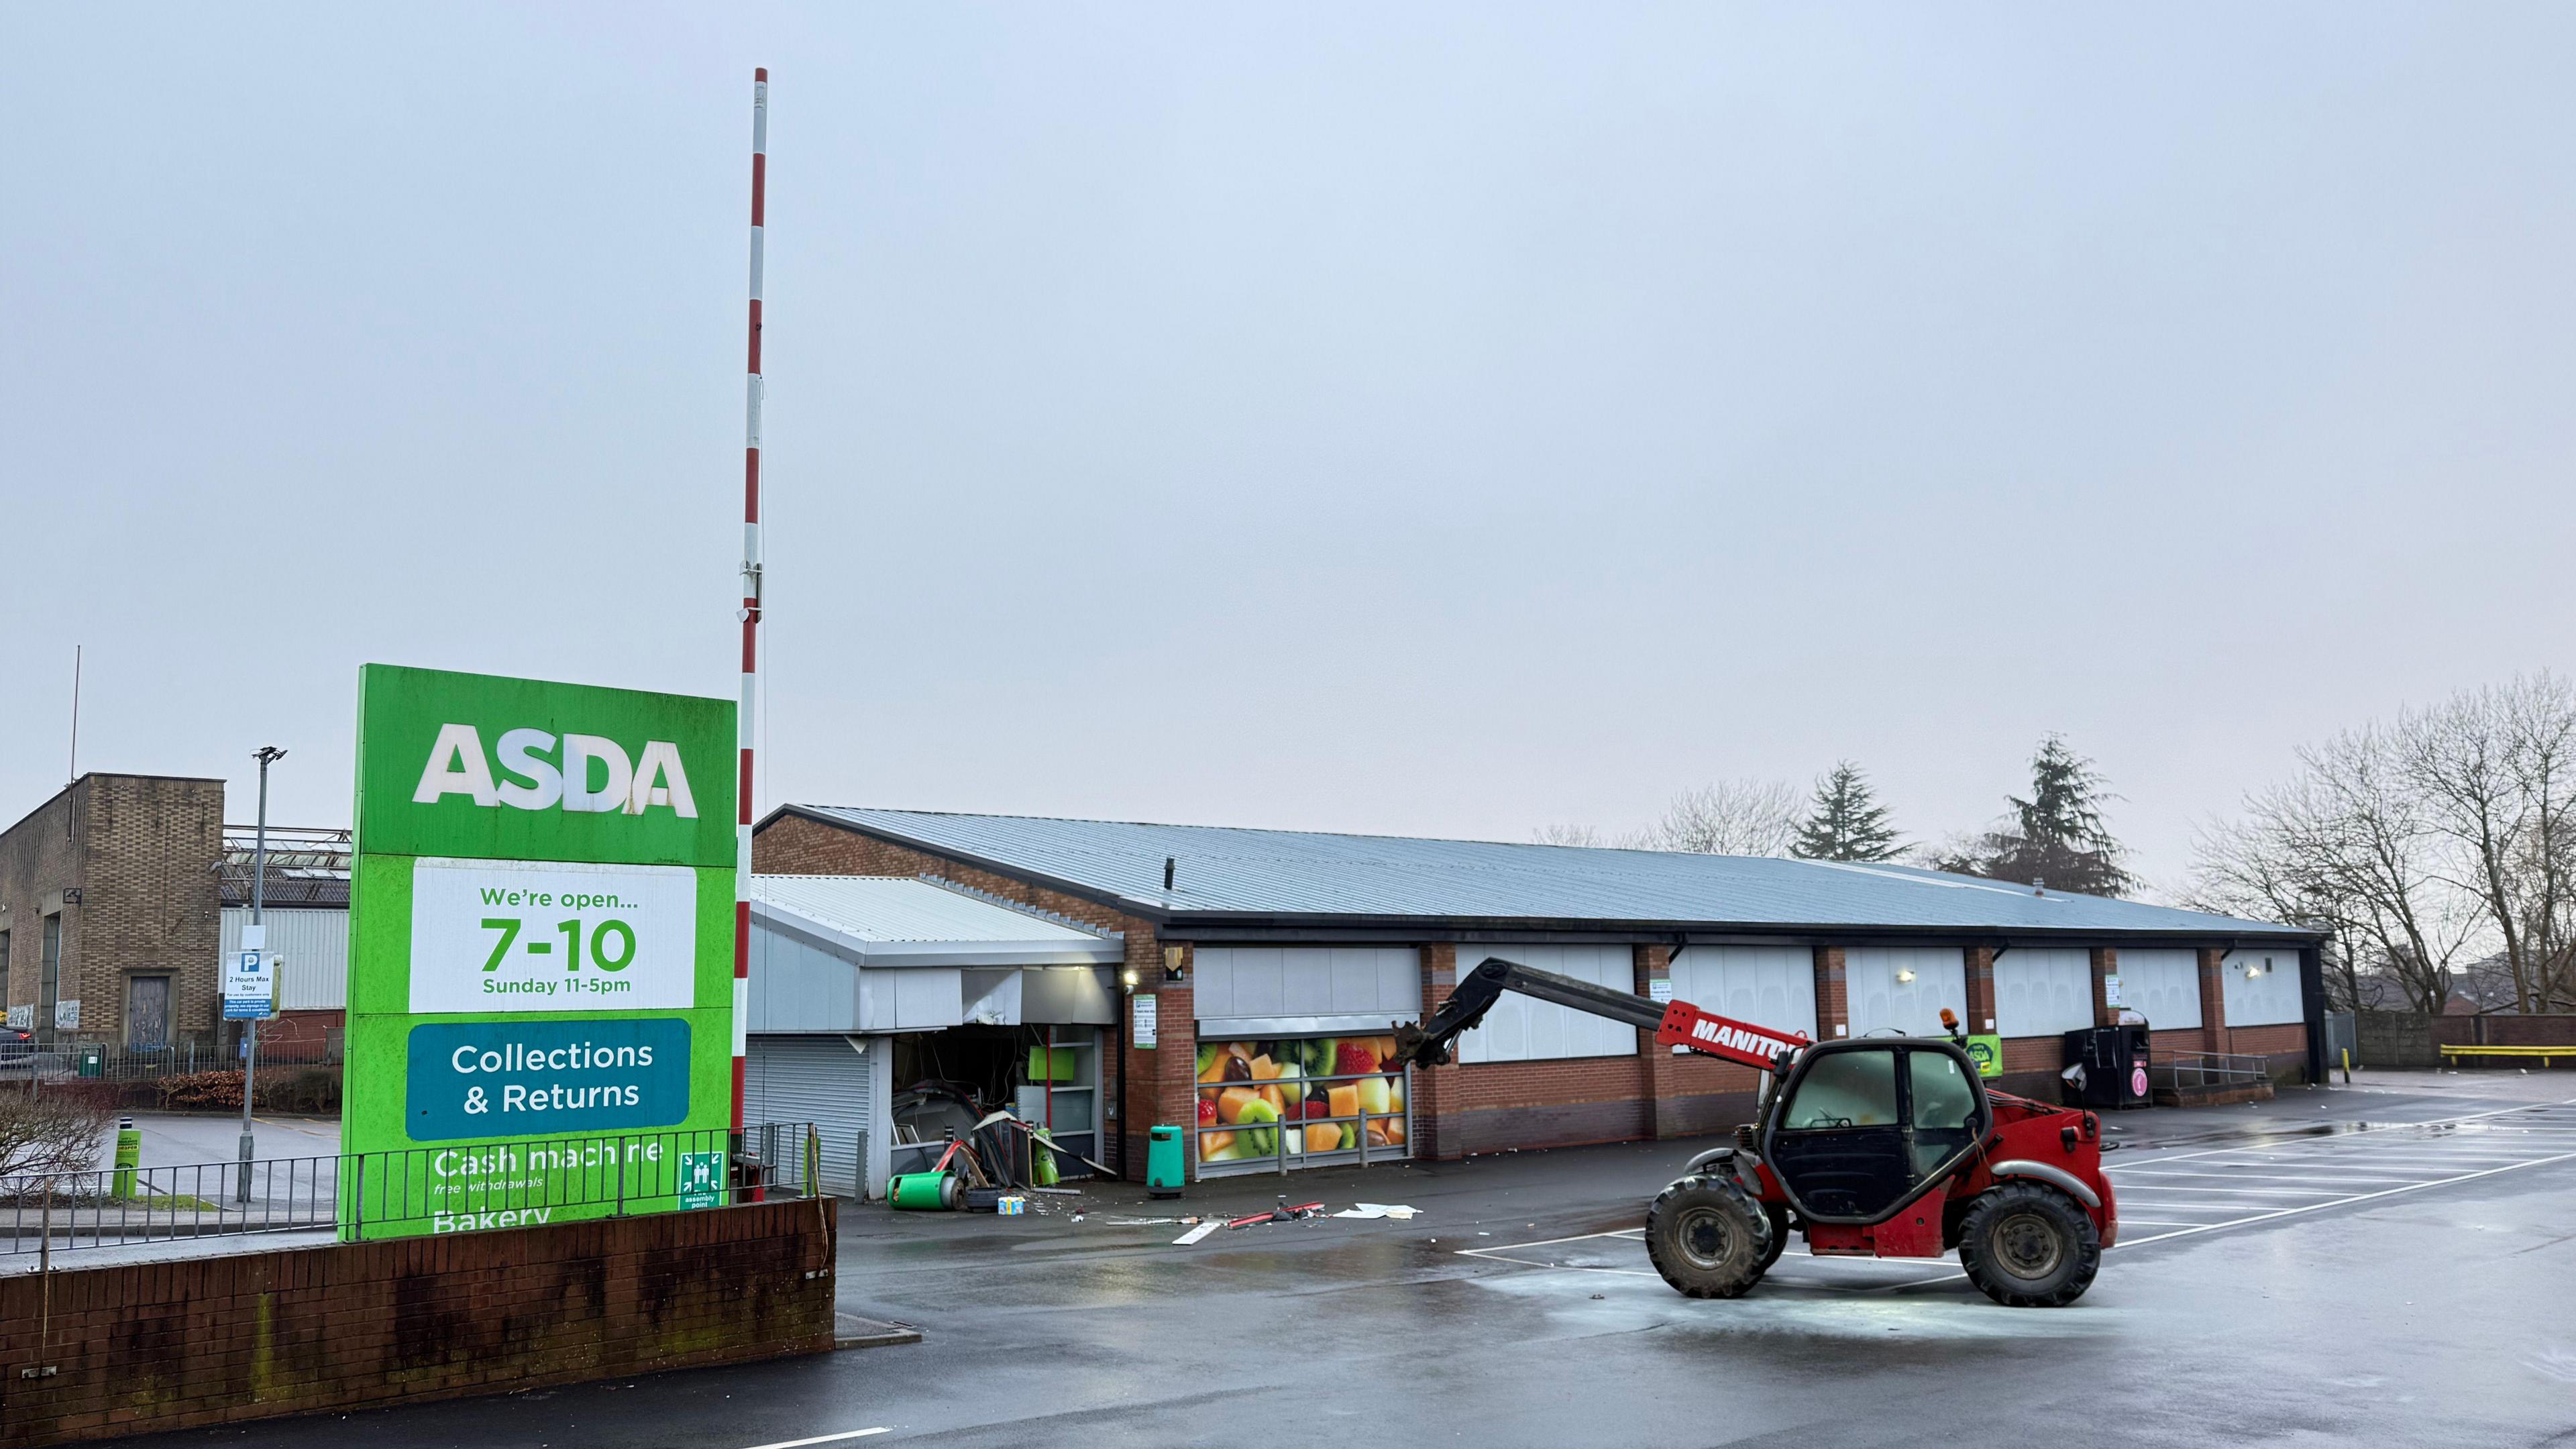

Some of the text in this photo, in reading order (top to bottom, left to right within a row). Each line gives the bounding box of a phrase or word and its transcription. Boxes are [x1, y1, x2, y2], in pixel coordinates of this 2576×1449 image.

[412, 722, 699, 818] ASDA
[480, 888, 638, 910] We’re open...
[481, 918, 637, 972] 7-10
[244, 955, 258, 971] P
[484, 978, 631, 996] Sunday 11-5pm
[451, 1041, 653, 1073] Collections
[464, 1084, 639, 1114] & Returns
[434, 1141, 663, 1177] Cash machne
[434, 1183, 461, 1195] free
